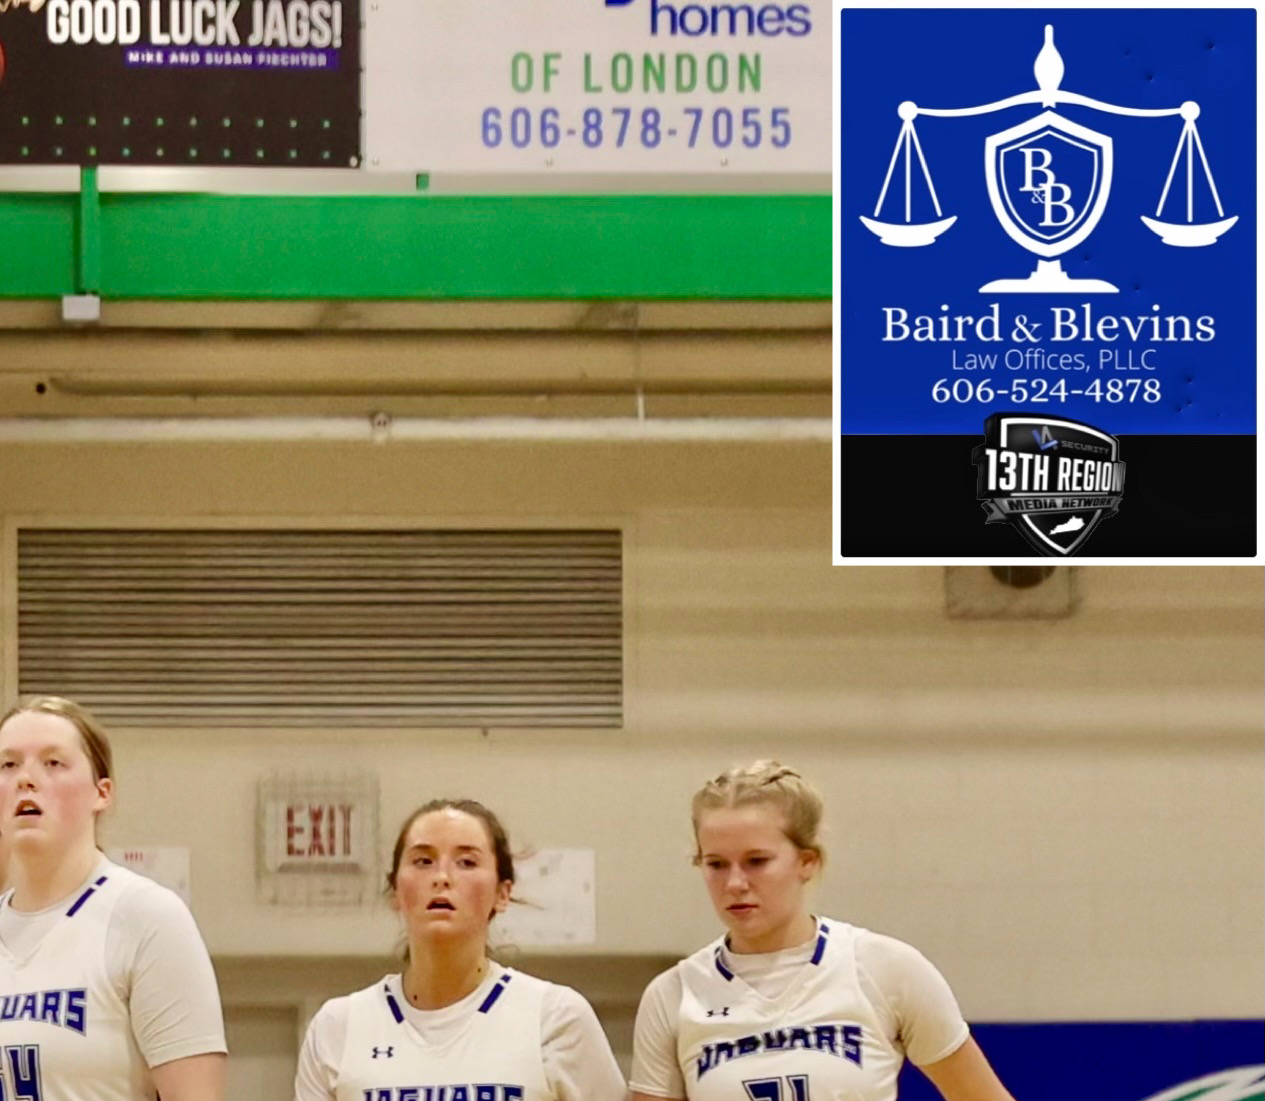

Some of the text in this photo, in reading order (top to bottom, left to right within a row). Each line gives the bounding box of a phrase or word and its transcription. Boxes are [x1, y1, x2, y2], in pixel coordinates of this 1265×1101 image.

[47, 0, 343, 49] GOOD LUCK JAGS!
[650, 0, 812, 37] homes
[128, 51, 164, 65] MIKE
[169, 52, 201, 65] AND
[511, 52, 762, 93] OF LONDON
[481, 107, 792, 149] 606-878-7055
[287, 805, 353, 856] EXIT
[697, 1025, 863, 1082] JAGUARS
